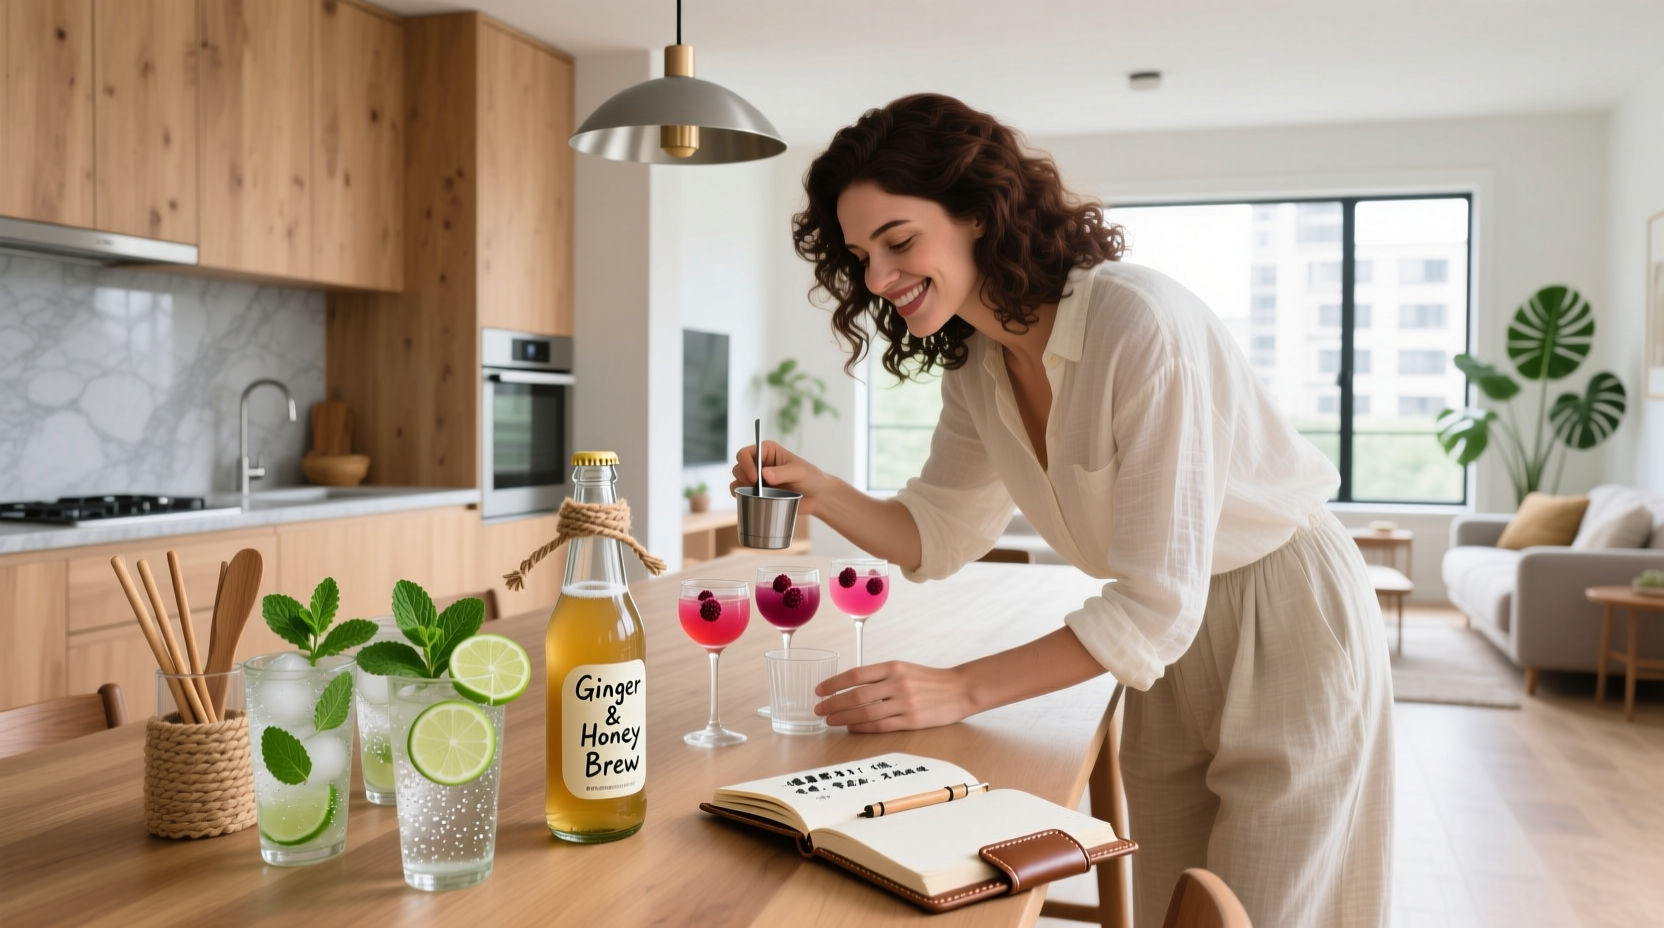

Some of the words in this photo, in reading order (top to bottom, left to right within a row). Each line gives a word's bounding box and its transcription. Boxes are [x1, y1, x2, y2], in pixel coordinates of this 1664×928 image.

[575, 674, 641, 705] Ginger
[605, 705, 621, 726] &
[580, 722, 641, 751] Honey
[585, 751, 640, 778] Brew
